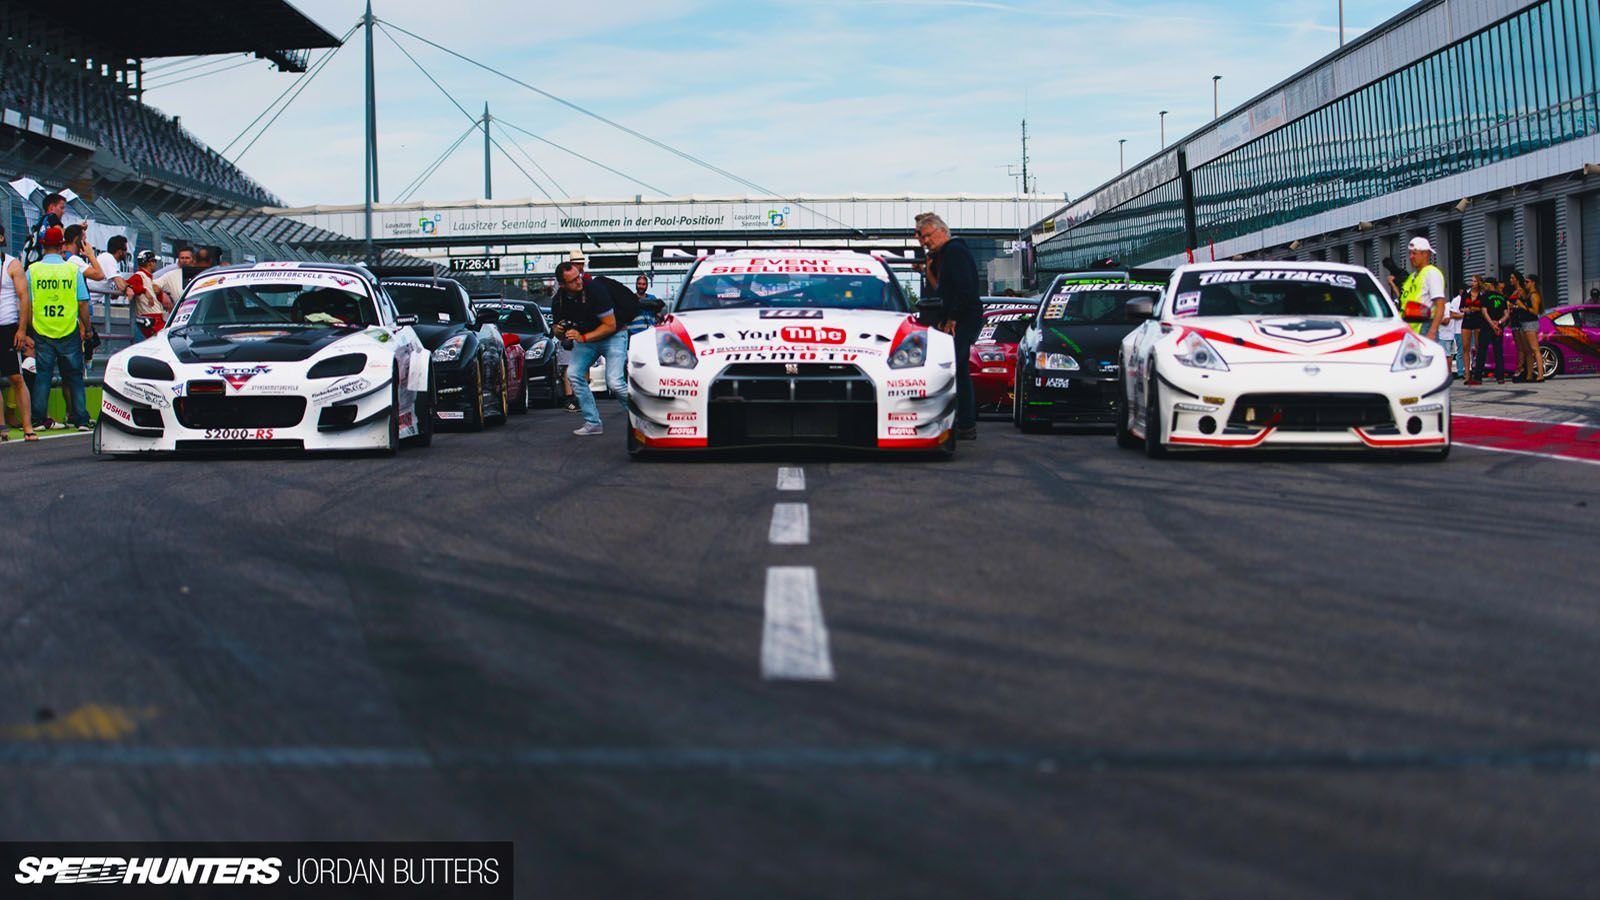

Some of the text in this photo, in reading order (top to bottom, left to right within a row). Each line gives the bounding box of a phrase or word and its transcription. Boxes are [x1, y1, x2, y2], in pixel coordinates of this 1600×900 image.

[453, 220, 498, 231] Lausitzer
[501, 219, 547, 230] Seenland
[559, 216, 621, 228] Willkommen
[623, 218, 633, 227] in
[635, 217, 652, 226] der
[653, 215, 725, 226] Pool-Position!
[453, 259, 497, 270] 17:26:41
[750, 258, 832, 266] EVENT
[711, 266, 872, 274] SEELISBERG
[1198, 270, 1338, 286] TIME ATTACK
[62, 279, 73, 289] TV
[381, 280, 432, 289] DYNAMICS
[43, 304, 65, 317] 162
[658, 377, 699, 388] NISSAN
[886, 378, 927, 388] NISSAN
[102, 400, 132, 422] TOSHIBA
[667, 412, 697, 421] PIRELLI
[888, 412, 918, 421] PIRELLI
[204, 428, 275, 441] S2000-RS
[669, 426, 697, 435] MOTUL
[889, 426, 917, 435] MOTUL
